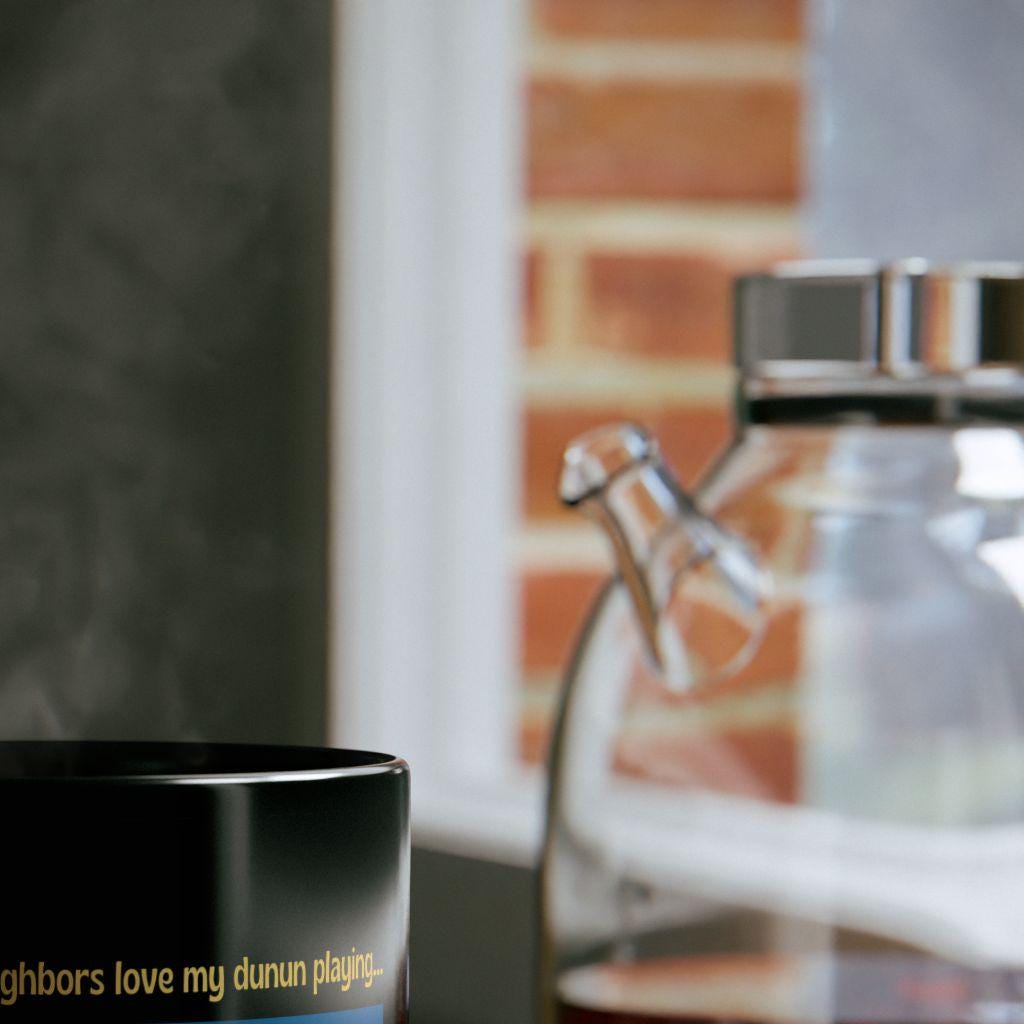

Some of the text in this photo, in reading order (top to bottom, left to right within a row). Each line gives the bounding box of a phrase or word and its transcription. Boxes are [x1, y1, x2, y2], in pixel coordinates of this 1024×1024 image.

[115, 960, 174, 995] love
[183, 965, 225, 1003] my
[232, 955, 308, 992] dunun
